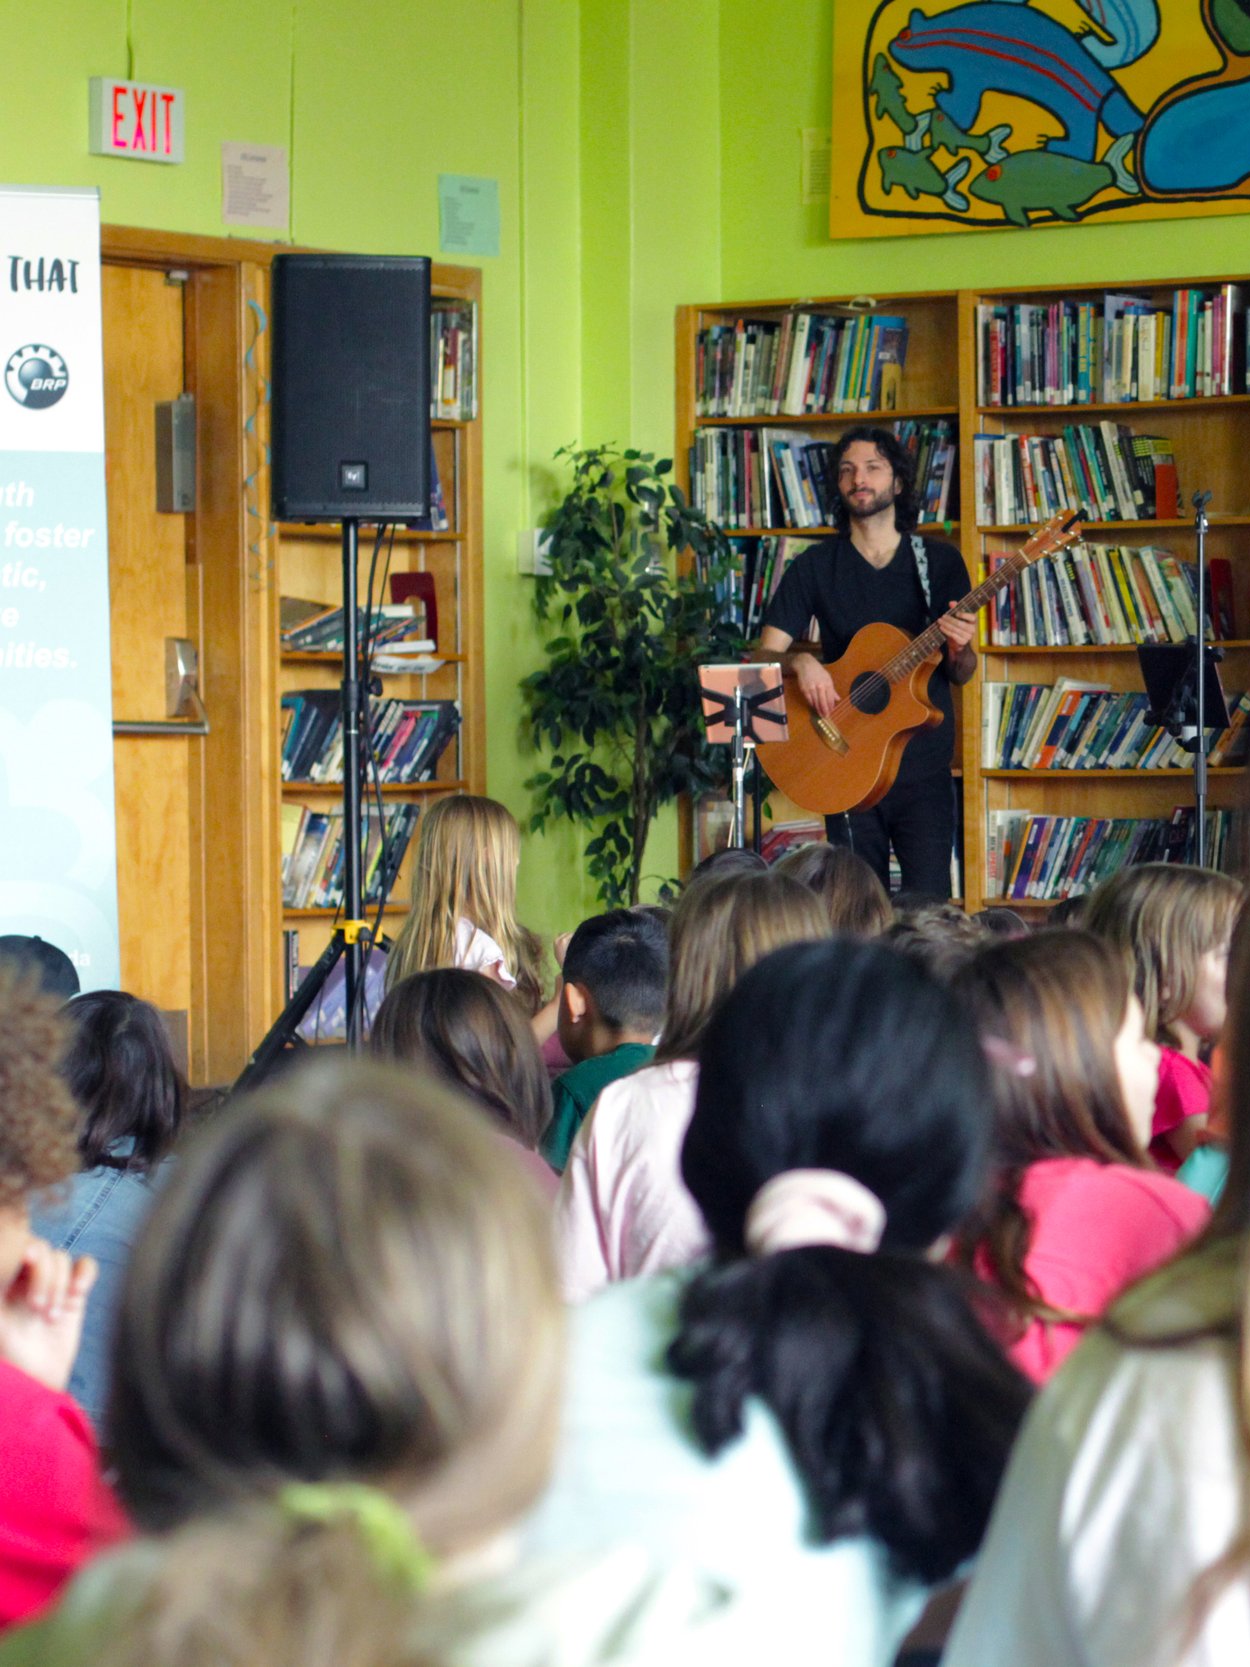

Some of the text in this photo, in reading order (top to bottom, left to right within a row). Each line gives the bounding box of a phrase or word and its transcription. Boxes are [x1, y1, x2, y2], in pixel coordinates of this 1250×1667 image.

[112, 86, 176, 155] EXIT
[8, 255, 80, 294] THAT
[30, 378, 67, 391] BRP
[4, 520, 96, 549] foster
[0, 561, 47, 592] tic,
